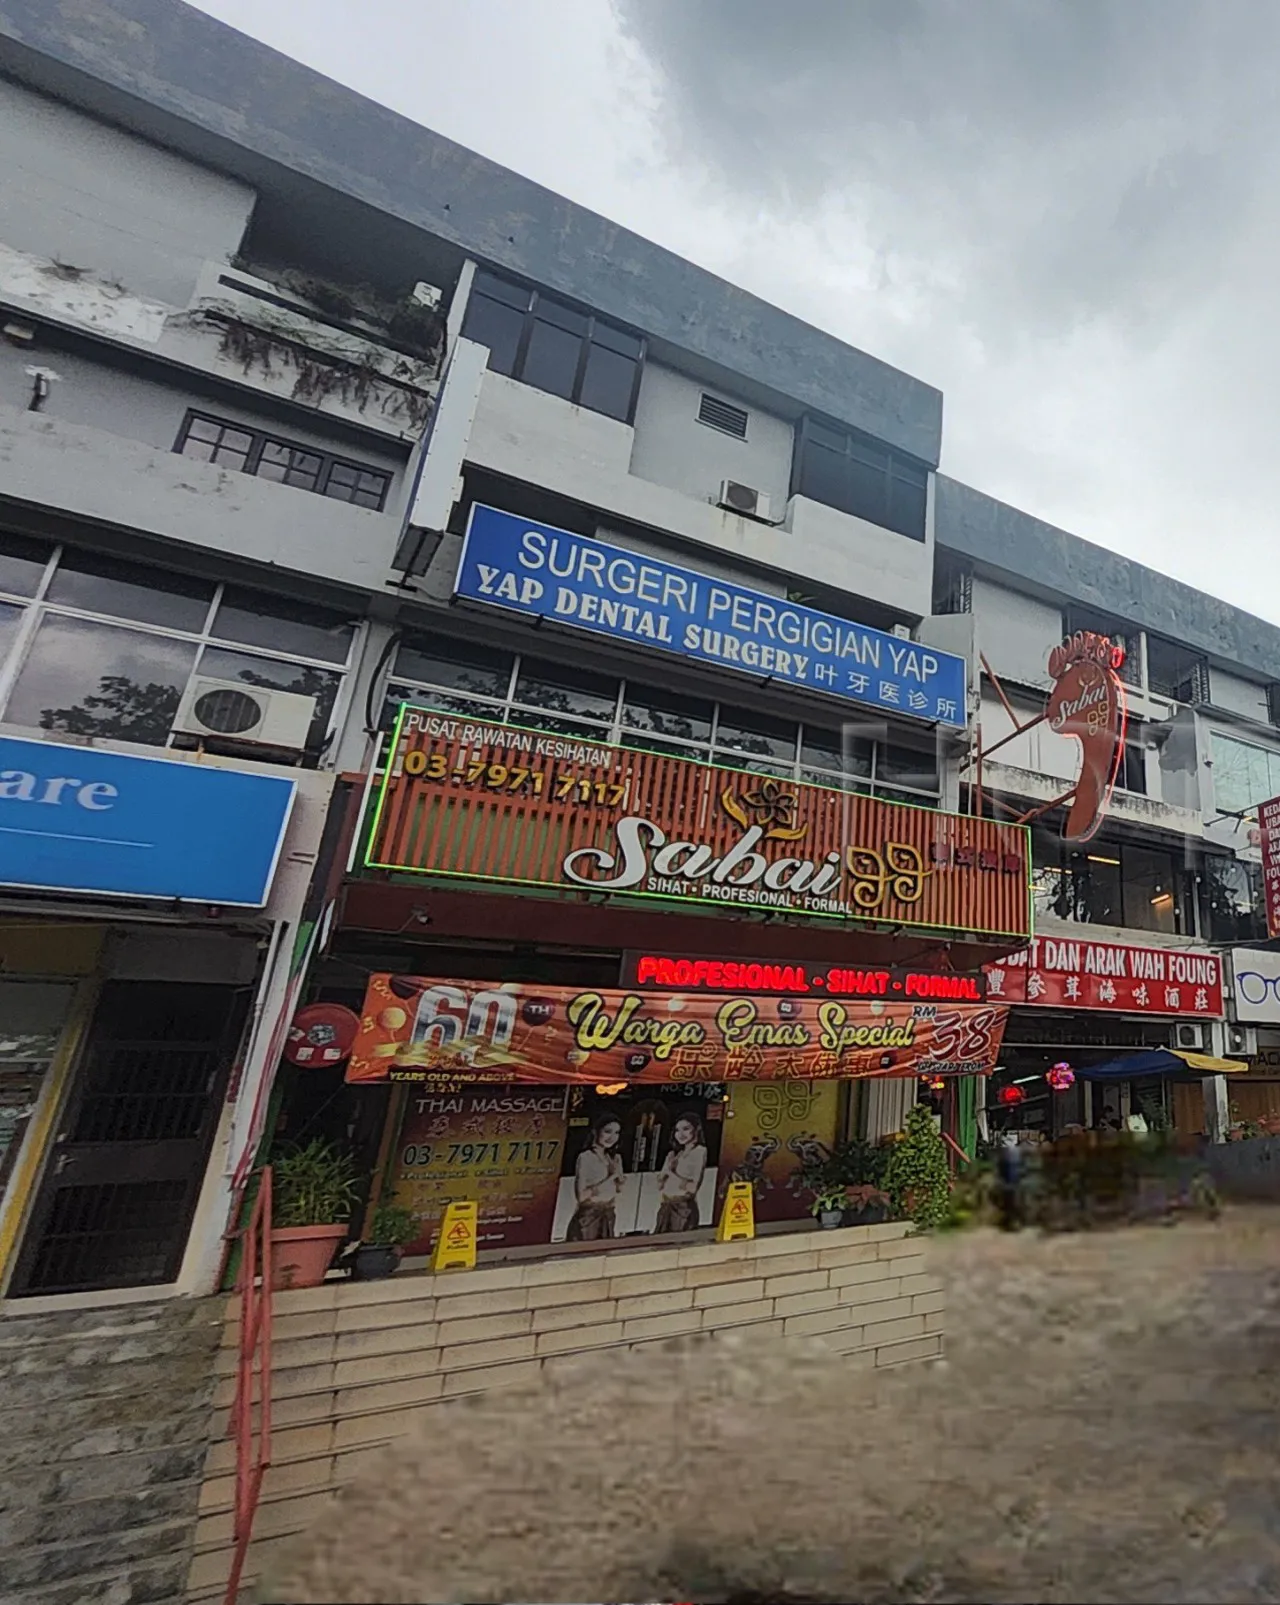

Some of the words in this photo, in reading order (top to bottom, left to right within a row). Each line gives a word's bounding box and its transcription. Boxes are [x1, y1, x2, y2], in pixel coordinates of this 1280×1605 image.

[476, 563, 544, 605] YAP
[554, 587, 673, 643] DENTAL
[683, 624, 809, 679] SURGERY
[518, 531, 698, 615] SURGERI
[708, 587, 881, 669] PERGIGIAN
[887, 643, 938, 684] YAP
[814, 662, 957, 719] 叶牙医诊所
[1052, 684, 1106, 730] Sabai
[406, 713, 459, 741] PUSAT
[462, 724, 532, 752] RAWATAN
[535, 739, 611, 769] KESIHATAN
[555, 775, 626, 806] 7117
[563, 816, 842, 896] Sabai
[647, 876, 689, 893] SIHAT
[702, 884, 794, 908] PROFESIONAL
[804, 896, 852, 914] FORMAL
[637, 956, 809, 993] PROFESIONAL
[826, 969, 889, 994] SIHAT
[904, 973, 981, 999] FORMAL
[1045, 940, 1081, 972] DAN
[1085, 945, 1126, 977] ARAK
[1130, 950, 1165, 981] WAH
[1169, 956, 1216, 985] FOUNG
[528, 1004, 549, 1014] TH
[567, 992, 705, 1061] Warga
[716, 998, 809, 1050] Emas
[818, 1001, 916, 1056] Special
[912, 1006, 937, 1018] RM
[929, 1007, 997, 1061] 38
[389, 1072, 425, 1081] YEARS
[427, 1072, 450, 1081] OLD
[452, 1073, 476, 1082] AND
[416, 1099, 464, 1113] THAI
[470, 1097, 567, 1113] MASSAGE
[507, 1141, 560, 1163] 7117
